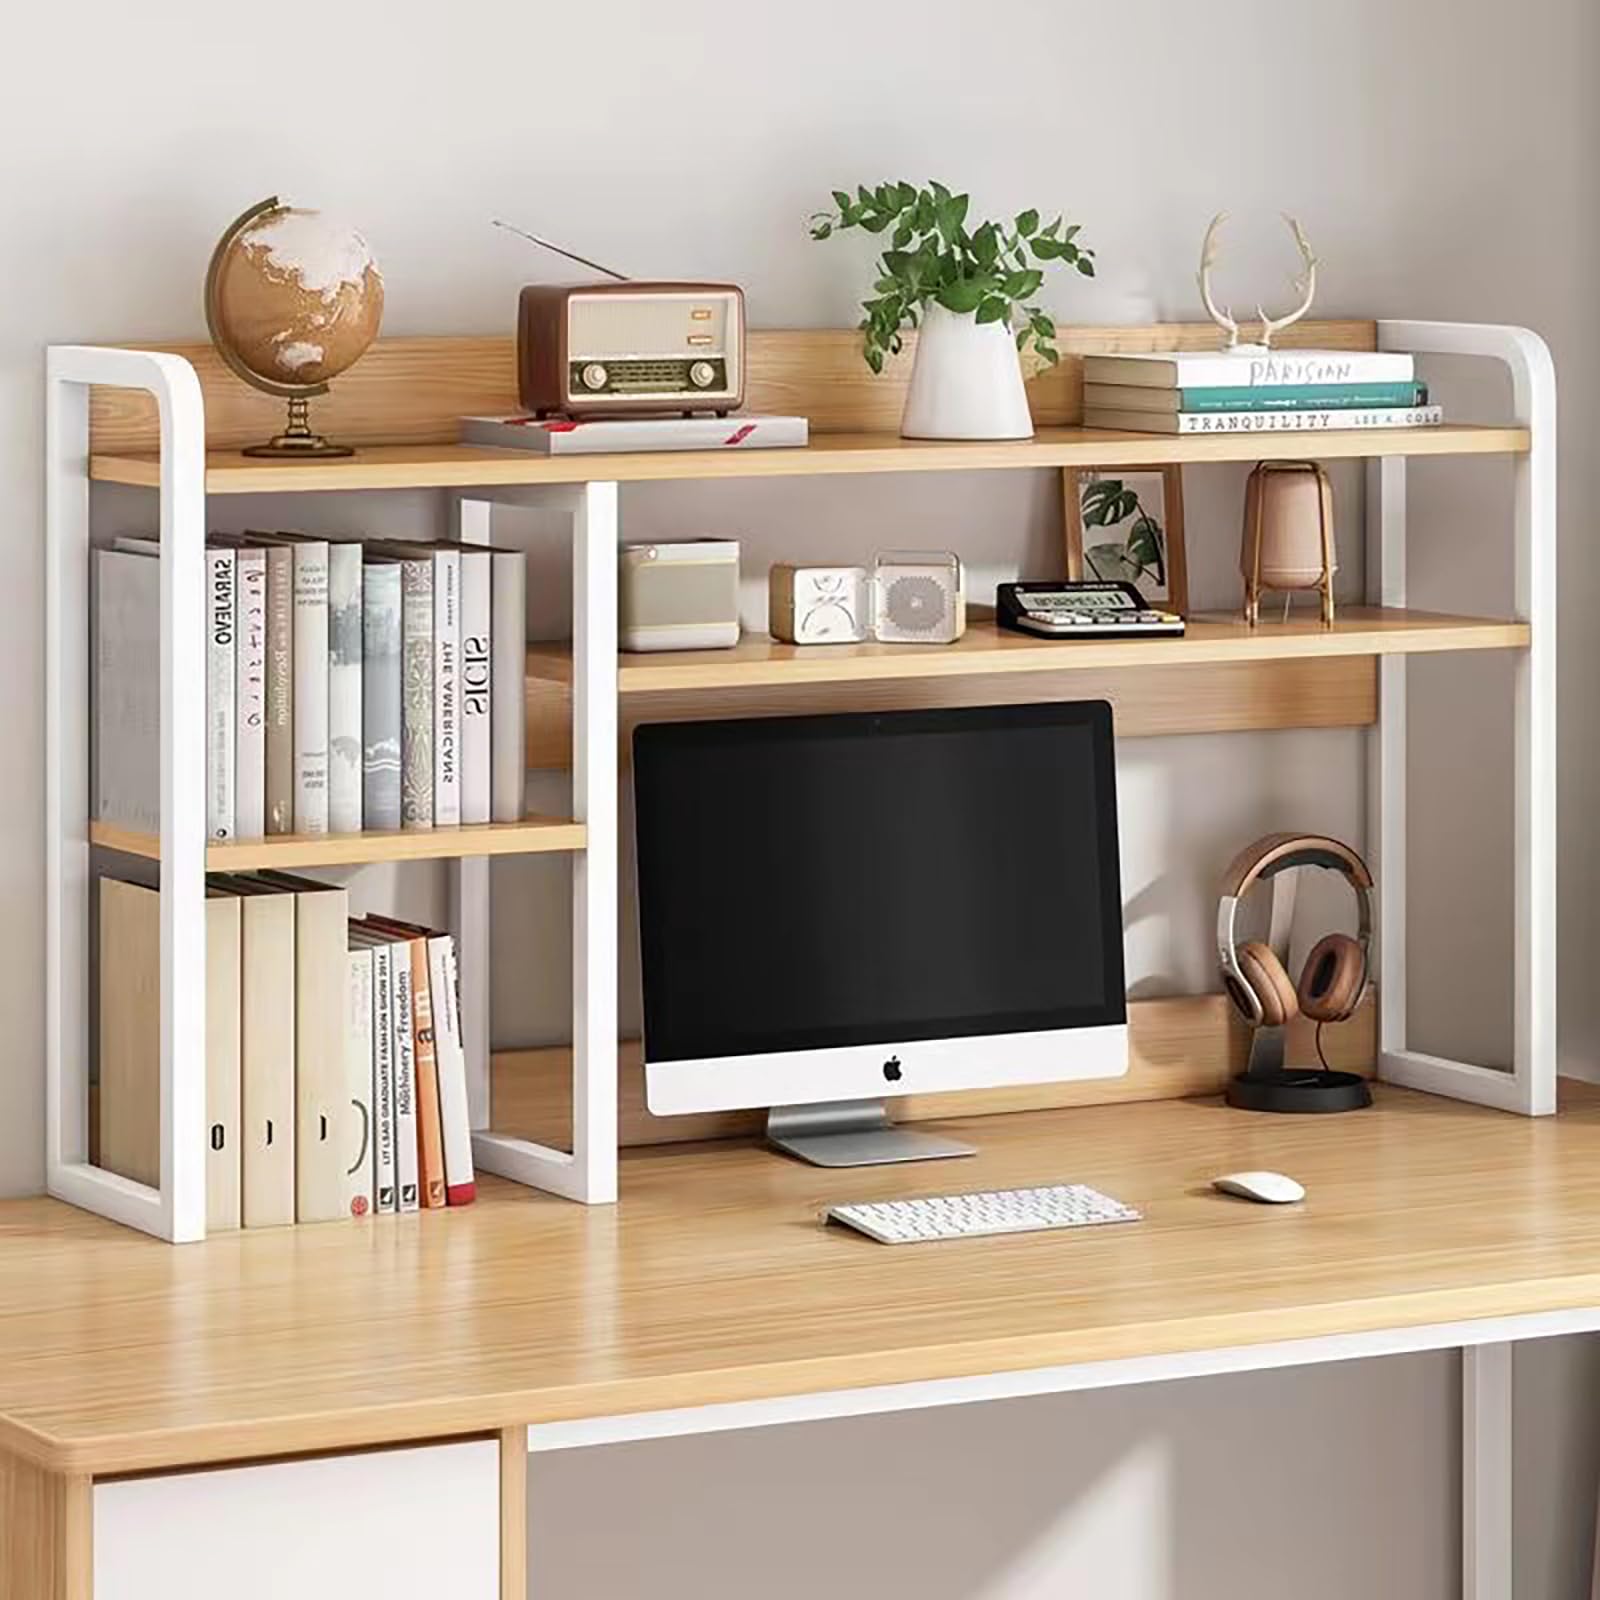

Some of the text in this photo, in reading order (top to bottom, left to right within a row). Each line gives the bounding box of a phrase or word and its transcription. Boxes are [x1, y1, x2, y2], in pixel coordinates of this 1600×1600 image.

[1250, 357, 1352, 387] PARISIAN
[1189, 414, 1330, 431] TRANQUILITY
[1406, 412, 1441, 426] COLE
[379, 979, 388, 1011] SHOW
[396, 971, 409, 1033] Freedom
[379, 1012, 388, 1060] FASHION
[380, 1064, 390, 1118] GRADUATE
[399, 1046, 412, 1115] Machinery
